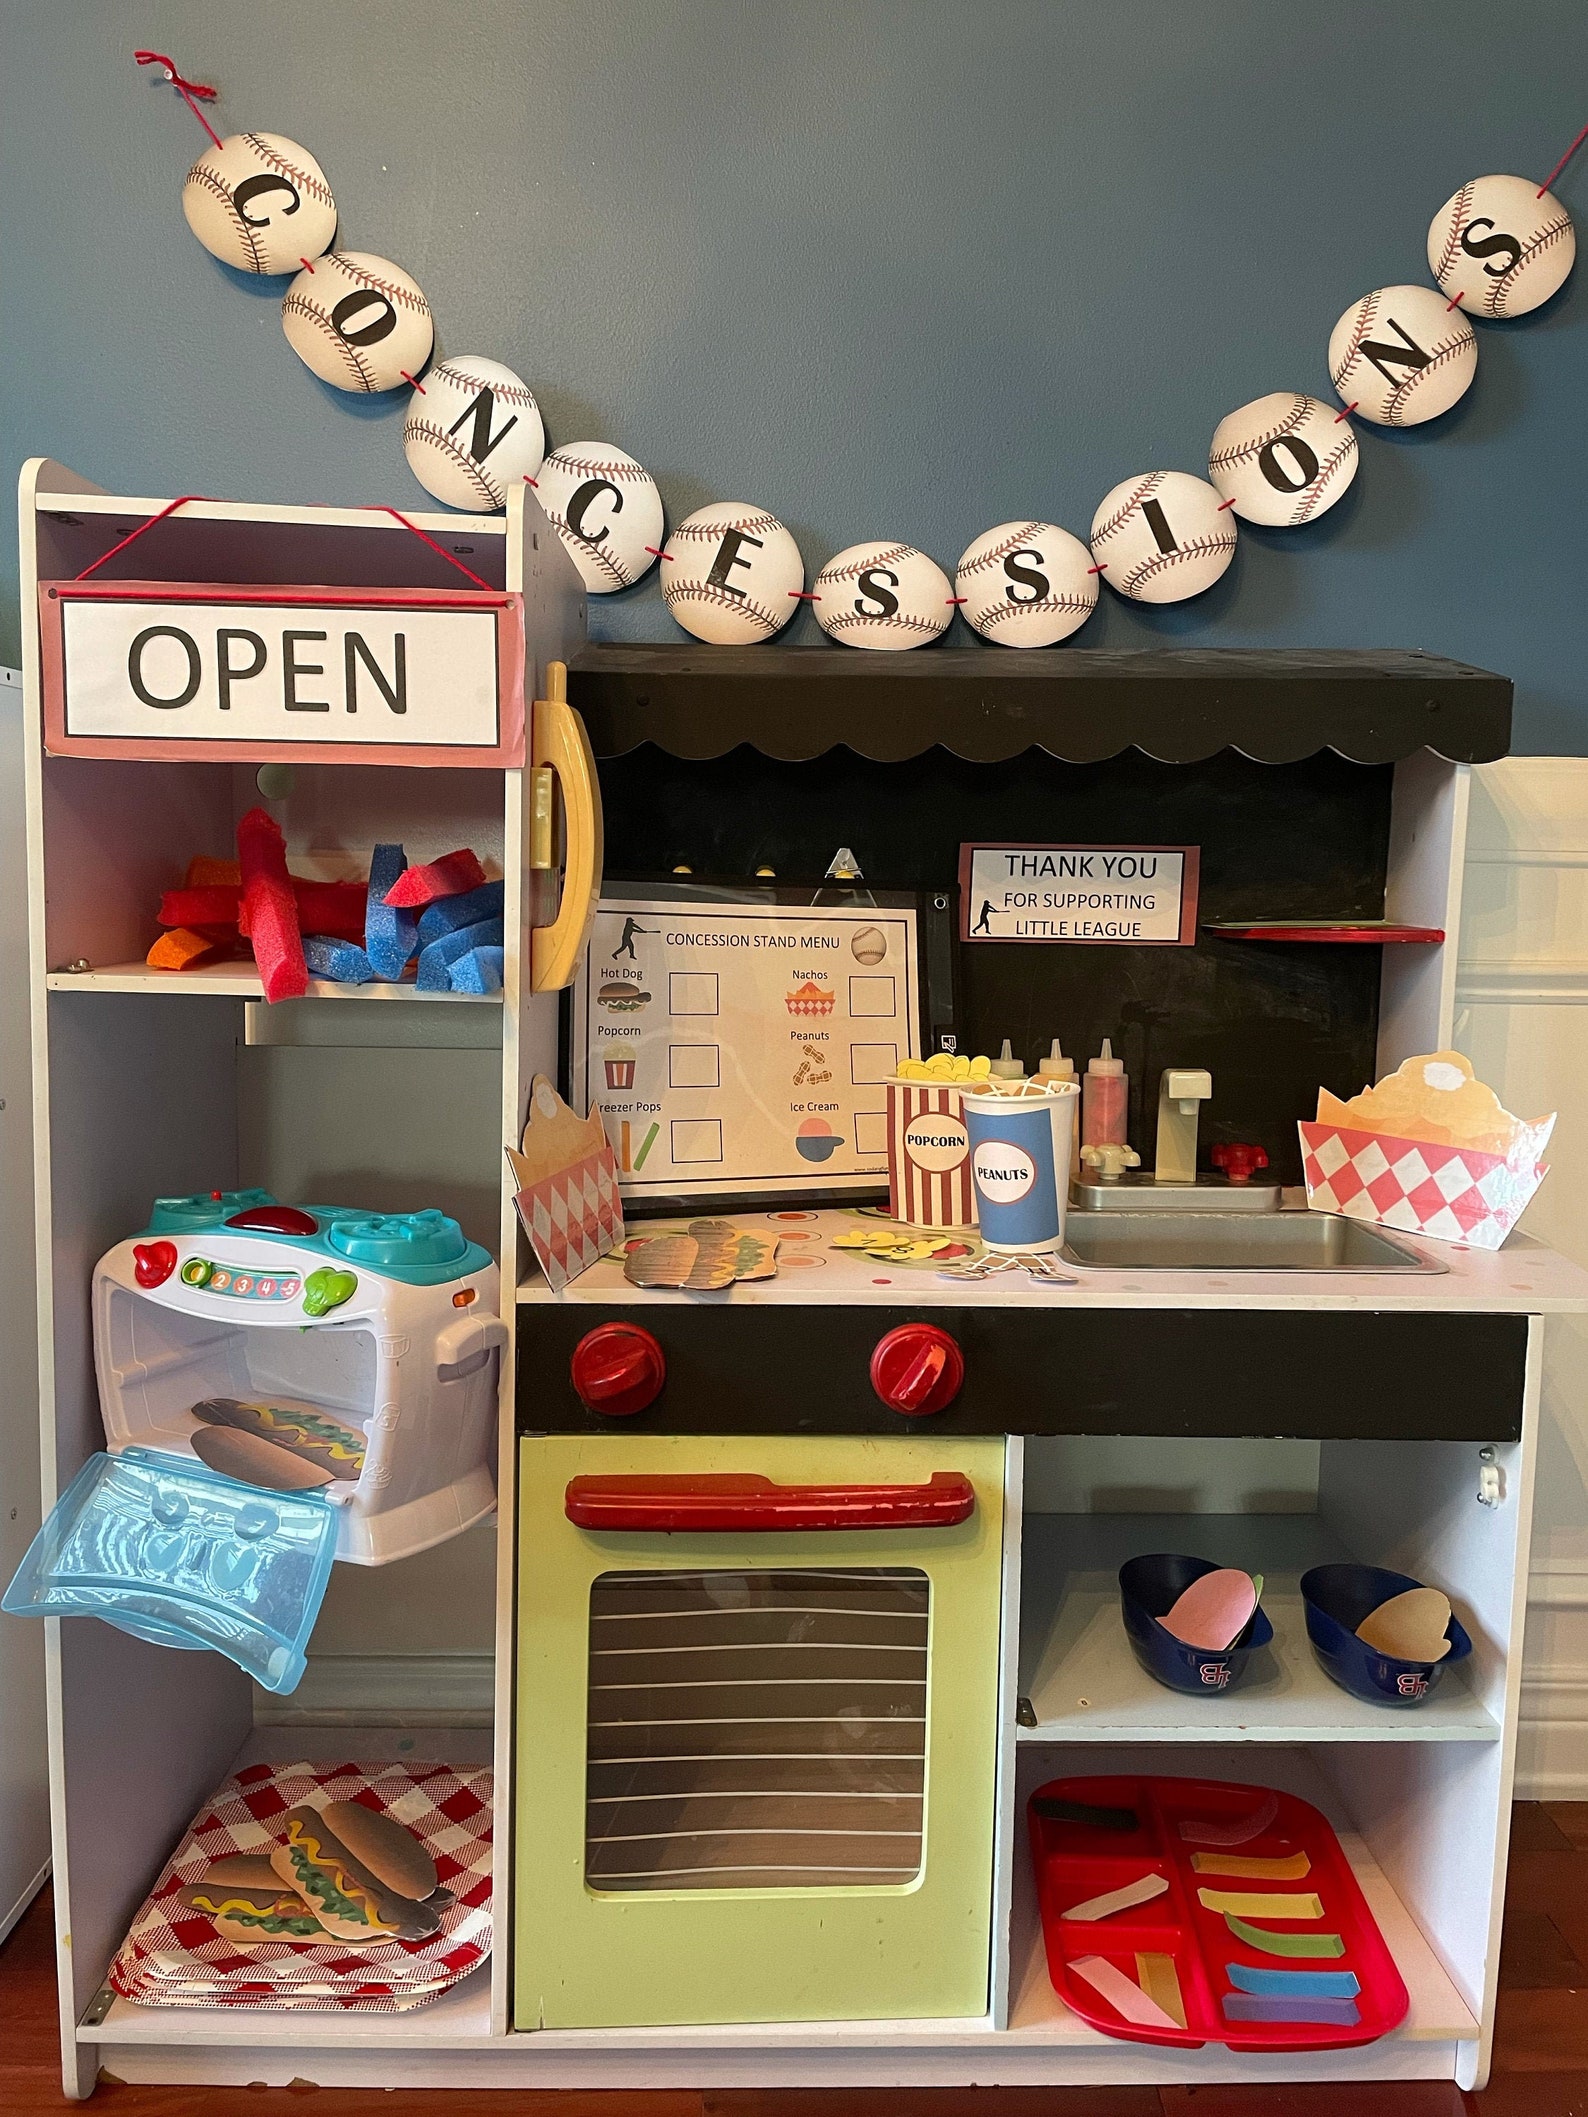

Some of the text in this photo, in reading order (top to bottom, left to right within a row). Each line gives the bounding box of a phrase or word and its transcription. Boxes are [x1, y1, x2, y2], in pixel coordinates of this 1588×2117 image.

[233, 173, 1521, 619] CONCESSIONS
[127, 624, 408, 715] OPEN
[1004, 854, 1157, 879] THANK YOU
[1004, 892, 1155, 910] FOR SUPPORTING
[1016, 920, 1141, 937] LITTLE LEAGUE
[666, 932, 840, 950] CONCESSION STAND MENU
[600, 967, 643, 981] Hot Dog
[792, 969, 829, 981] Nachos
[597, 1025, 641, 1039] Popcorn
[790, 1030, 830, 1042] Peanuts
[597, 1101, 662, 1113] reezer Pops
[790, 1101, 839, 1113] Ice Cream
[907, 1134, 965, 1147] POPCORN
[977, 1165, 1028, 1181] PEANUTS
[215, 1274, 226, 1287] 2
[238, 1279, 248, 1292] 3
[262, 1282, 270, 1295] 4
[286, 1283, 295, 1295] 5
